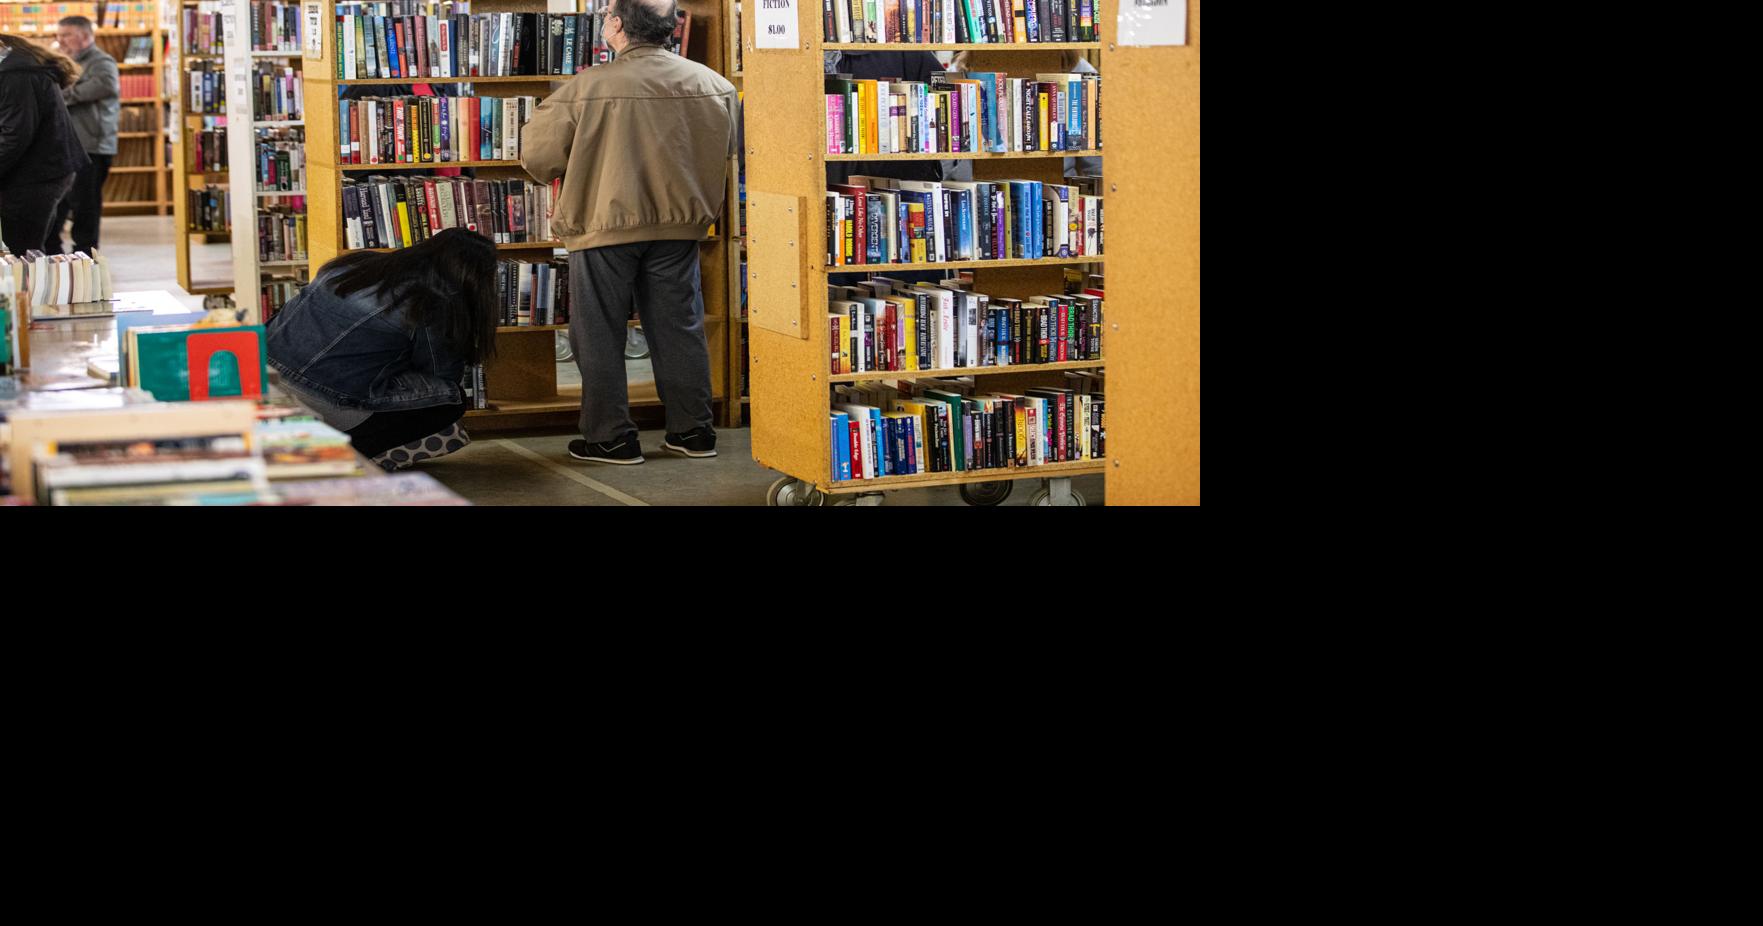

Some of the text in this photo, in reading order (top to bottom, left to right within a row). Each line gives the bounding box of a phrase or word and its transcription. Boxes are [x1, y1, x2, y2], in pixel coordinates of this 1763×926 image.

[763, 0, 790, 8] FICTION
[768, 24, 785, 35] $1.00
[845, 220, 853, 237] HAROLD
[871, 213, 879, 252] DIVERGENT
